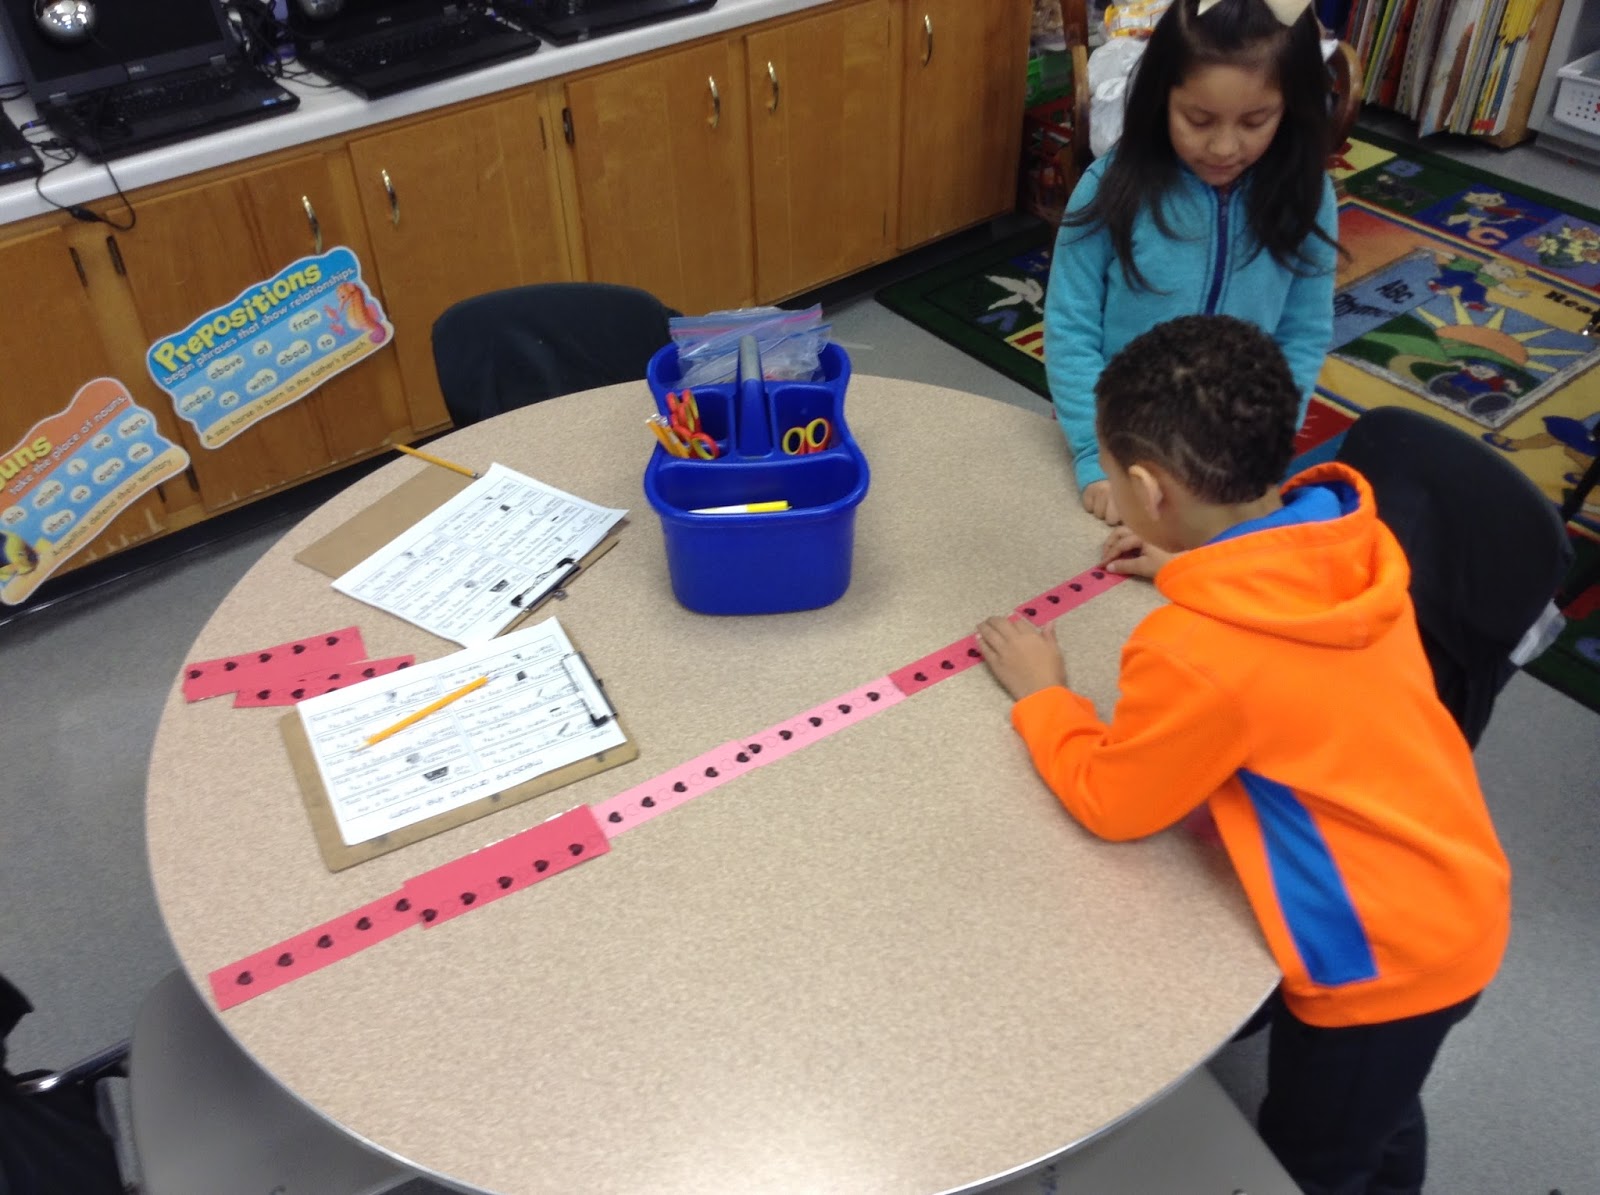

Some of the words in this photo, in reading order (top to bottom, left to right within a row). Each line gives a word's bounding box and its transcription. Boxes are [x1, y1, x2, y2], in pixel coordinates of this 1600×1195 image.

[153, 264, 322, 372] Prepositions
[292, 312, 319, 332] from
[164, 363, 195, 384] begin
[196, 337, 237, 367] phrases
[238, 322, 260, 339] that
[262, 305, 288, 327] show
[257, 342, 271, 355] at
[320, 337, 333, 348] to
[280, 342, 310, 366] about
[210, 357, 243, 380] above
[250, 373, 275, 391] with
[182, 389, 213, 412] under
[222, 394, 237, 406] on
[121, 415, 147, 436] hers
[95, 436, 112, 450] we
[132, 446, 149, 459] me
[9, 474, 34, 495] take
[33, 458, 52, 474] the
[52, 433, 80, 460] place
[80, 419, 93, 434] of
[98, 461, 121, 482] ours
[36, 483, 62, 507] mine
[73, 488, 88, 501] us
[6, 508, 25, 525] his
[48, 511, 73, 533] they
